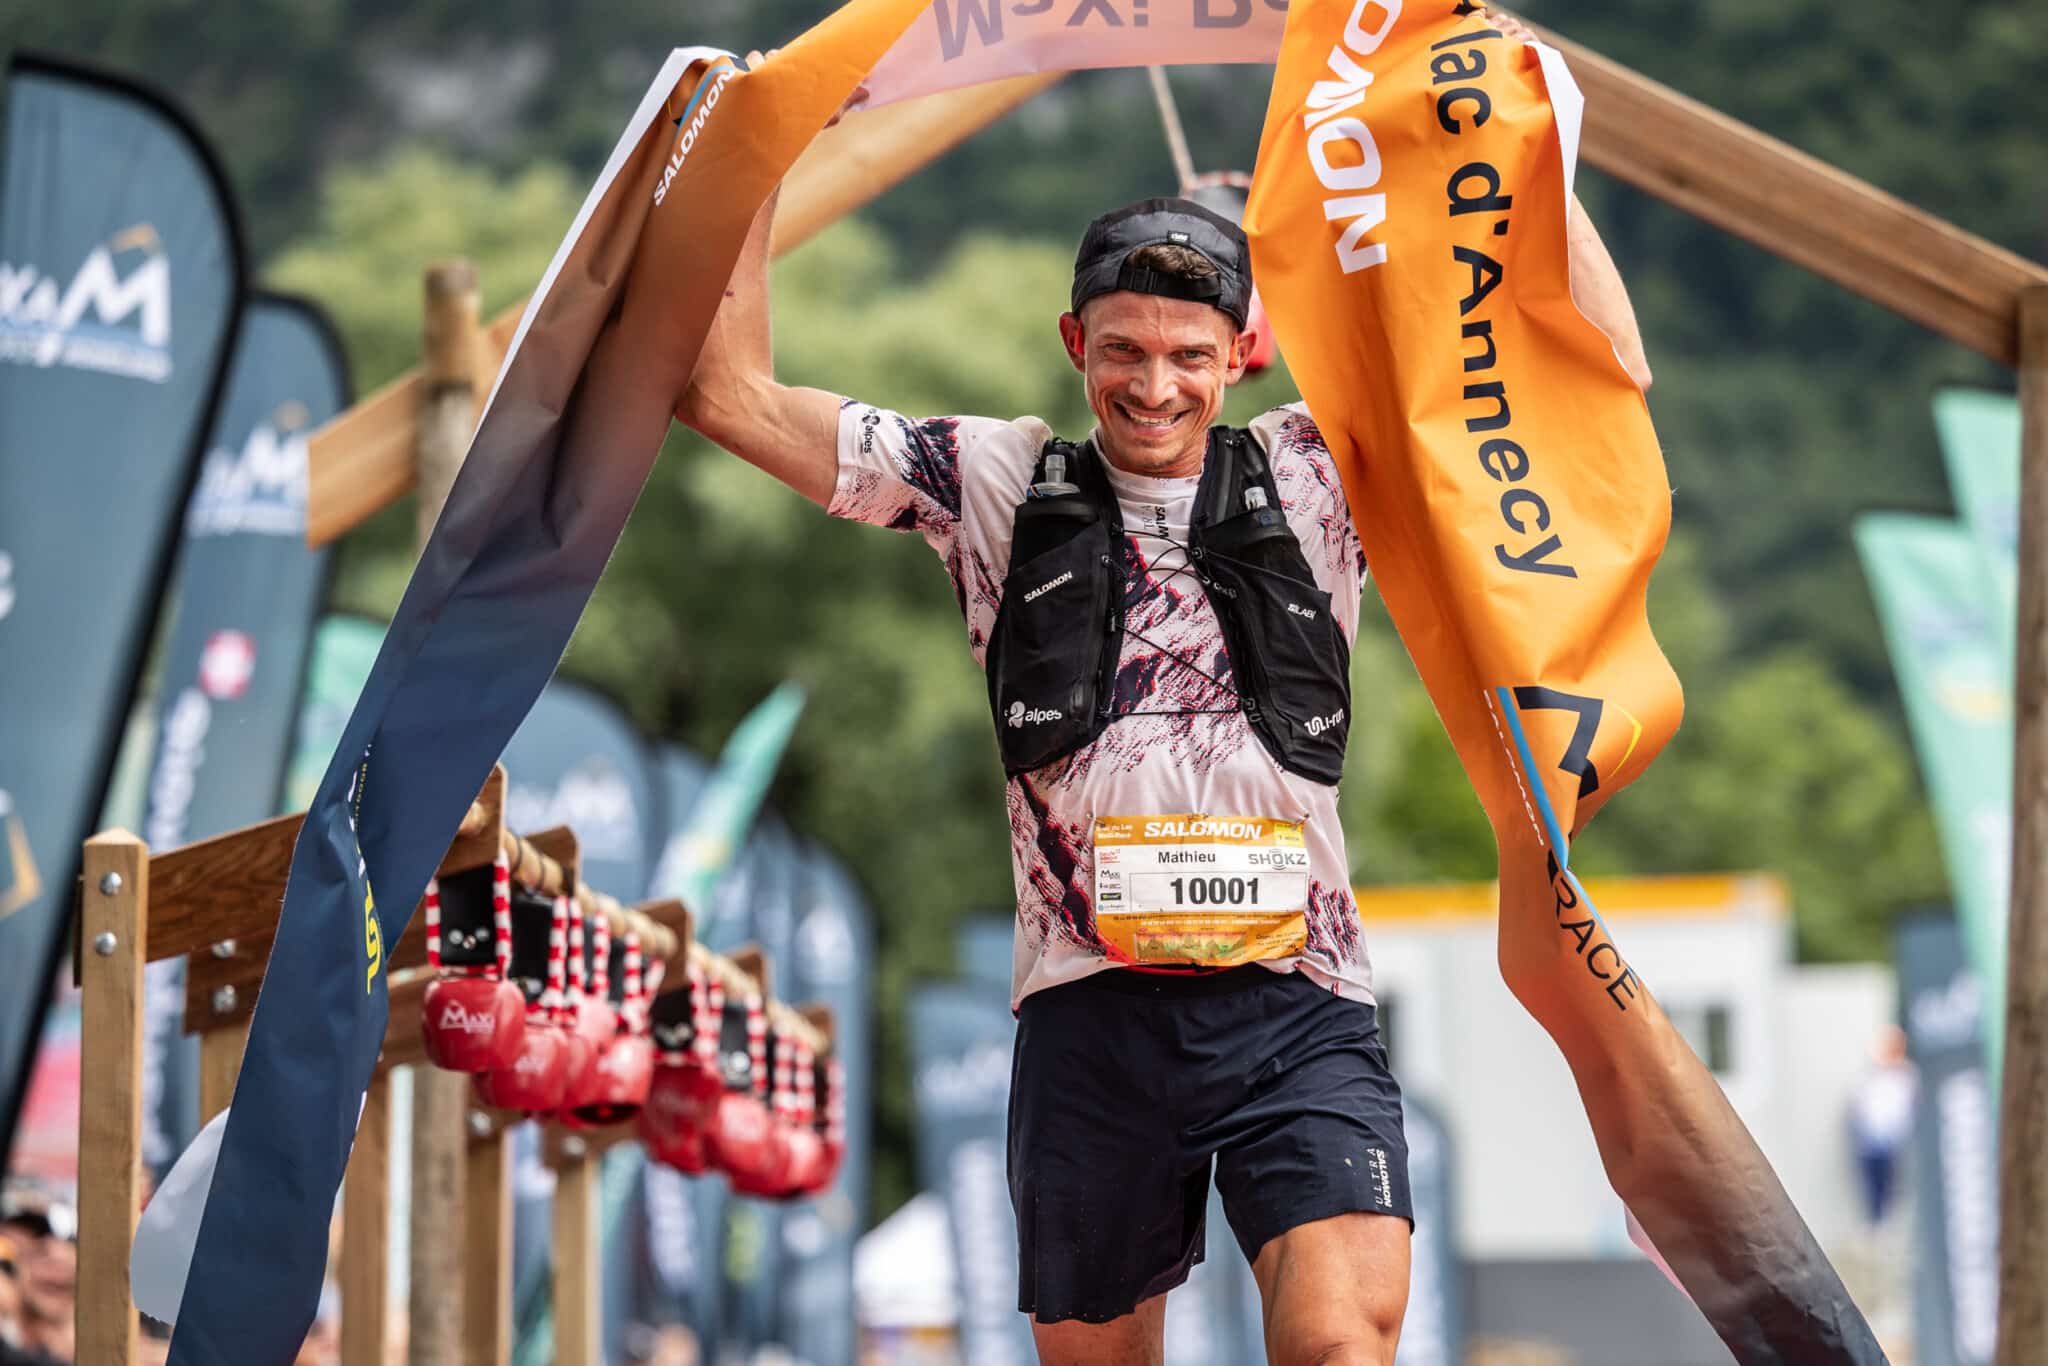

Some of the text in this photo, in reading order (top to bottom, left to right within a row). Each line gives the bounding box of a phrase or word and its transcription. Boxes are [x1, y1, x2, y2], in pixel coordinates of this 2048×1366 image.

[1430, 28, 1503, 135] lac
[653, 68, 736, 208] SALOMON
[1446, 162, 1578, 579] d'Annecy
[1024, 571, 1073, 603] SALOMON
[1025, 708, 1062, 725] alpes
[1143, 821, 1263, 840] SALOMON
[1158, 851, 1216, 864] Mathieu
[1248, 852, 1307, 866] SHOKZ
[1170, 877, 1259, 905] 10001
[1553, 876, 1641, 1011] RACE
[1376, 1148, 1393, 1208] SALOMON
